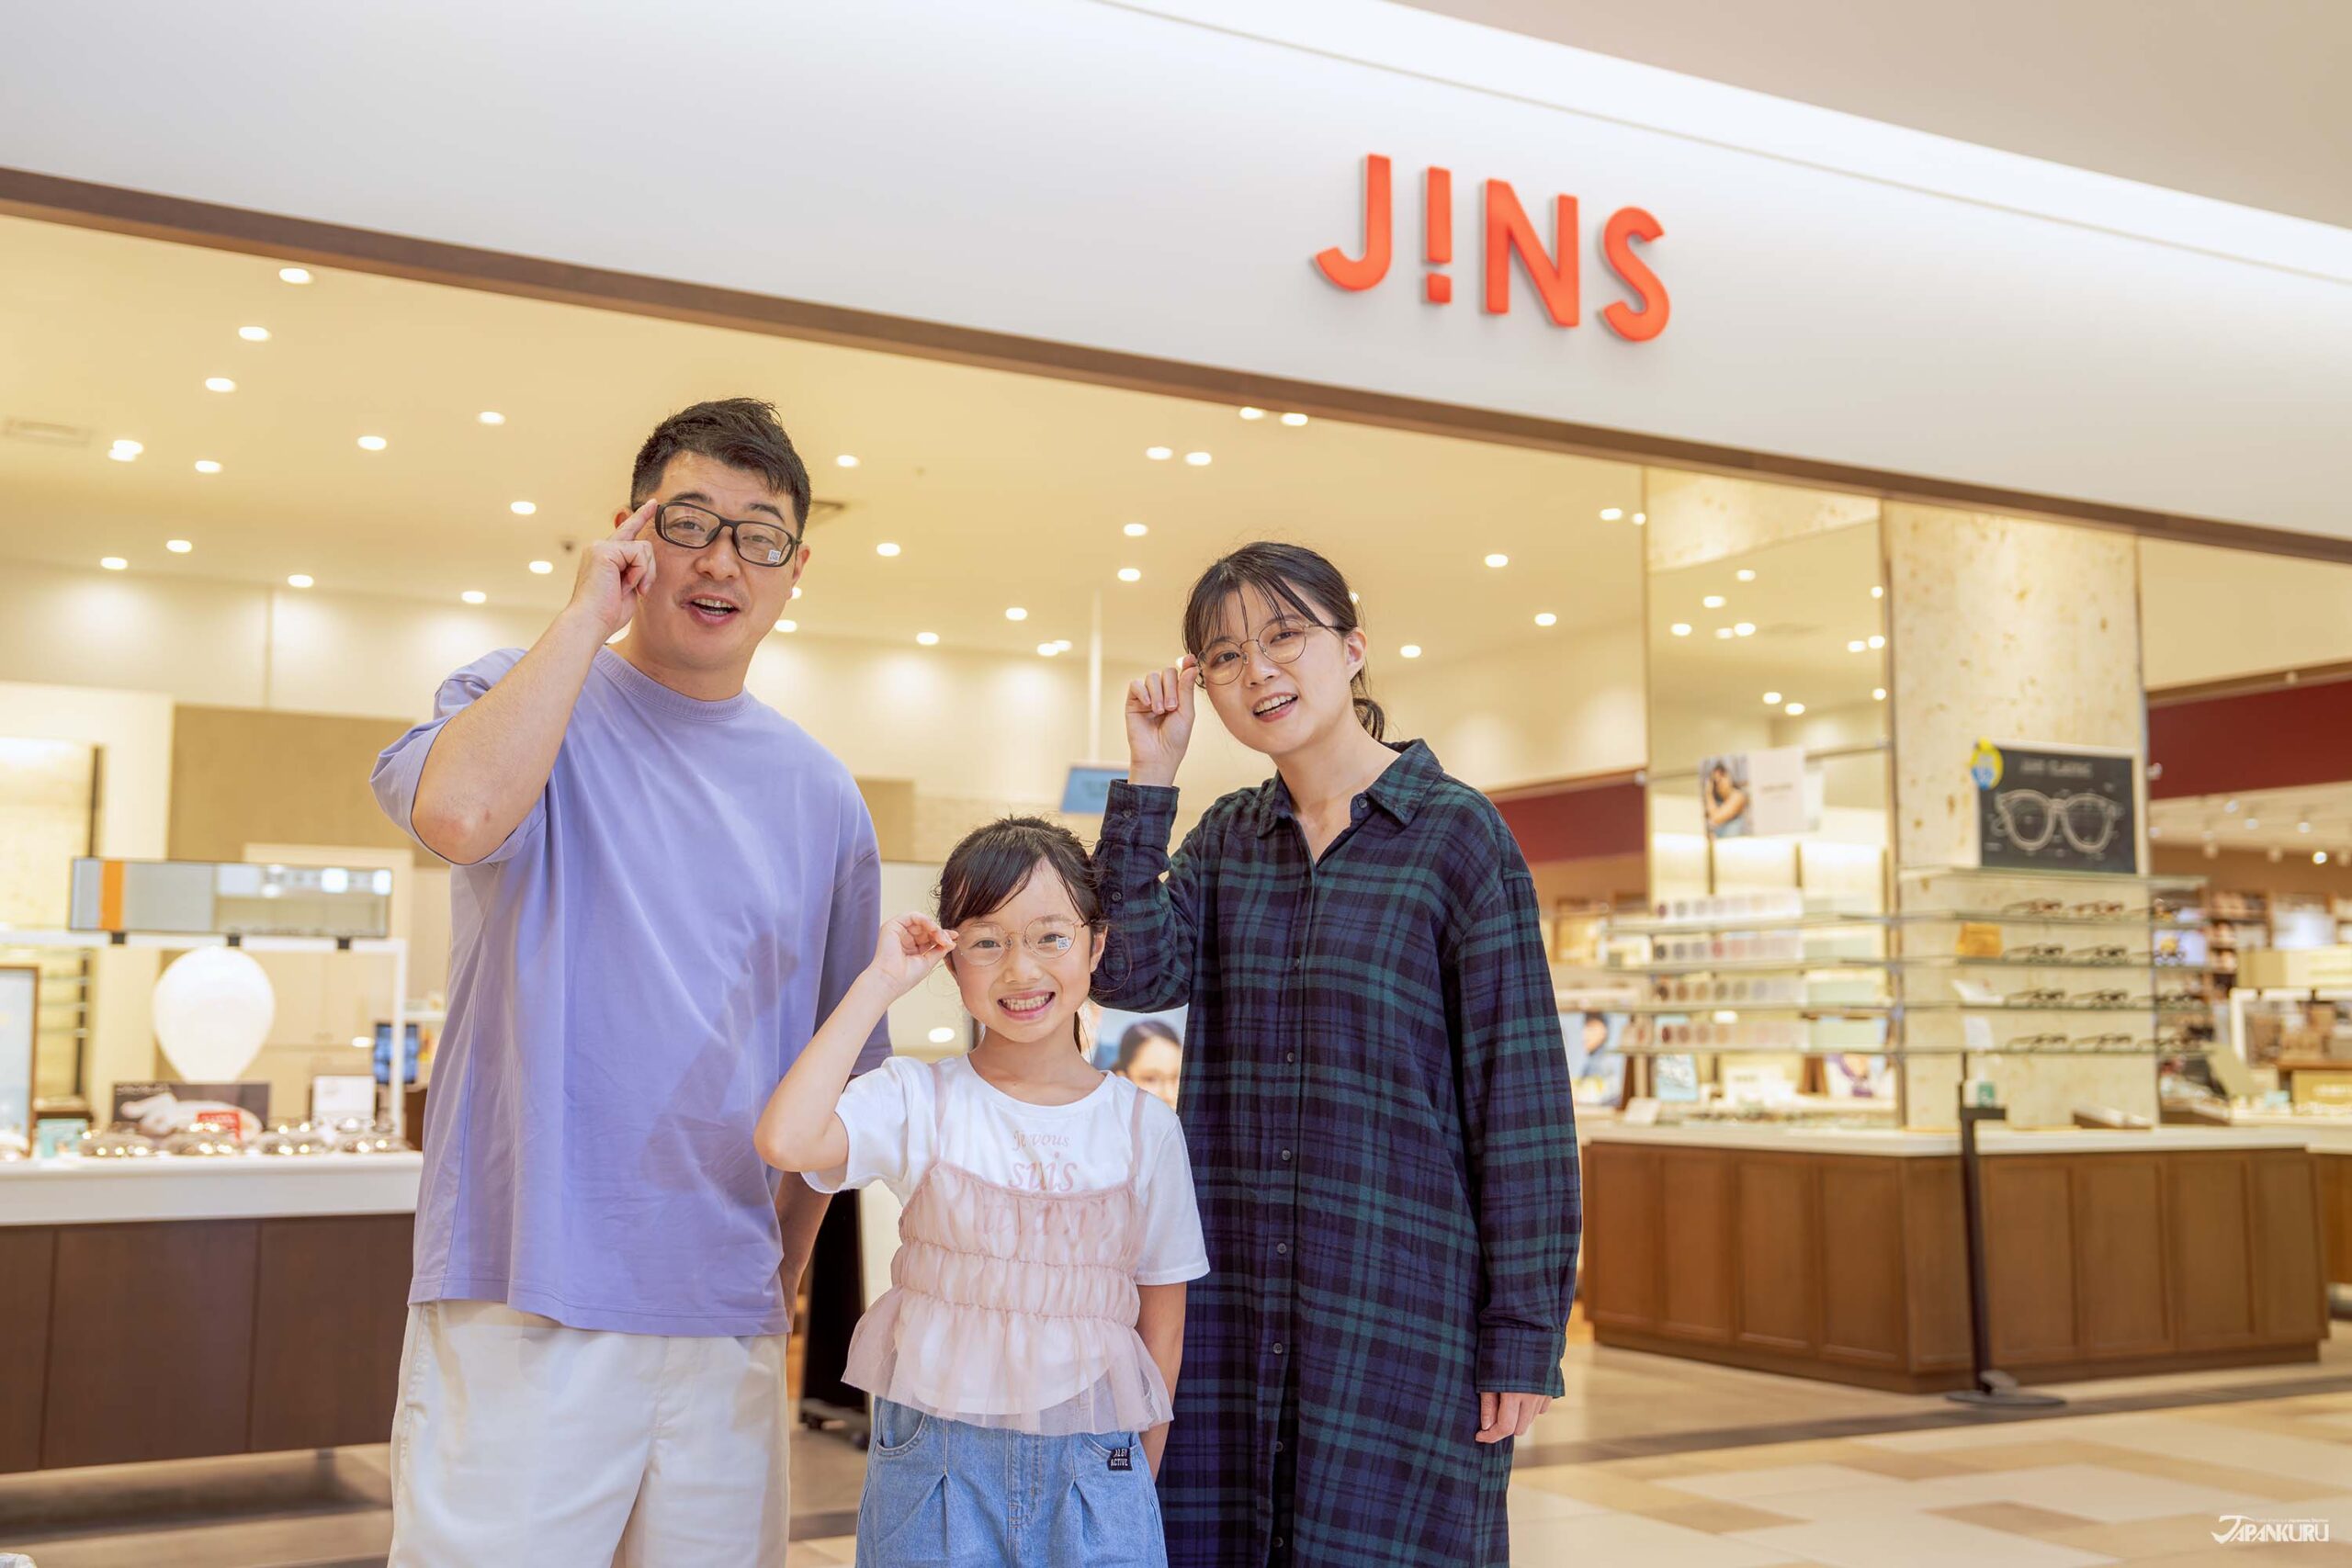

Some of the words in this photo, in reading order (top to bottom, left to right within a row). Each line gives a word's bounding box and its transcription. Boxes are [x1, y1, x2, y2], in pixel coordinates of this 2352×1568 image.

[1031, 1133, 1070, 1147] vous
[1008, 1151, 1078, 1192] suis
[1110, 1458, 1129, 1467] ACTIVE
